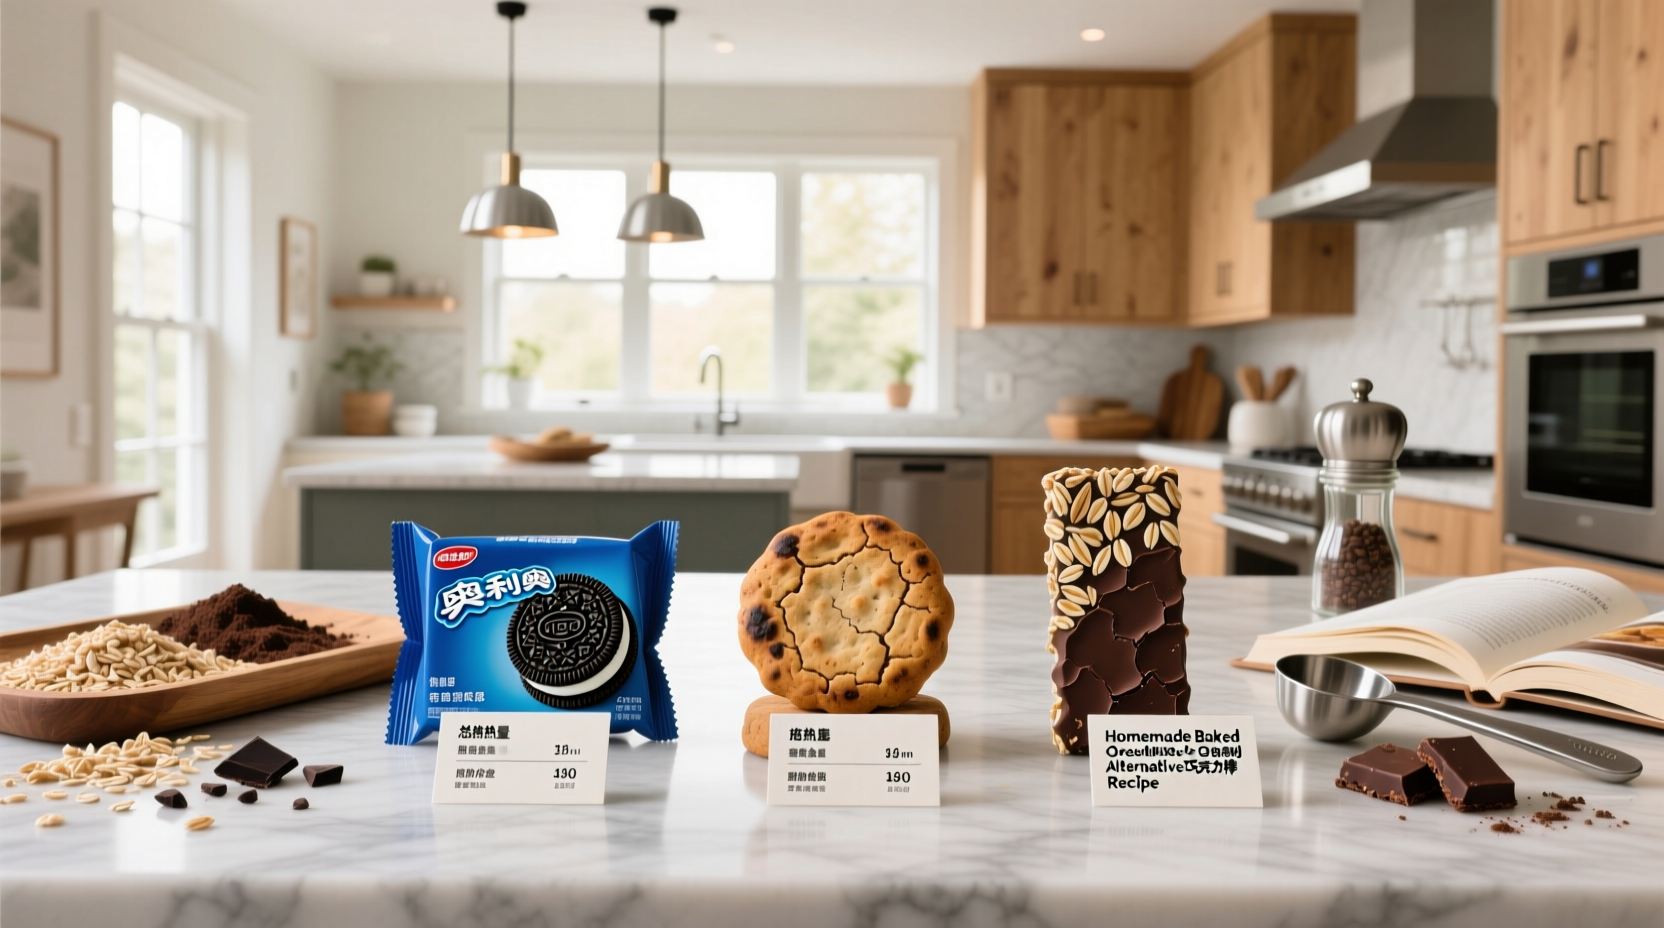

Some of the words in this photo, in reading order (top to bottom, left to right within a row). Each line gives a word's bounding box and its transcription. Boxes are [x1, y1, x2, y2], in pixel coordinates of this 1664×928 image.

[440, 568, 551, 620] 奥利奥
[1105, 728, 1191, 743] Homemade
[1195, 728, 1240, 743] Baked
[1107, 775, 1160, 793] Recipe
